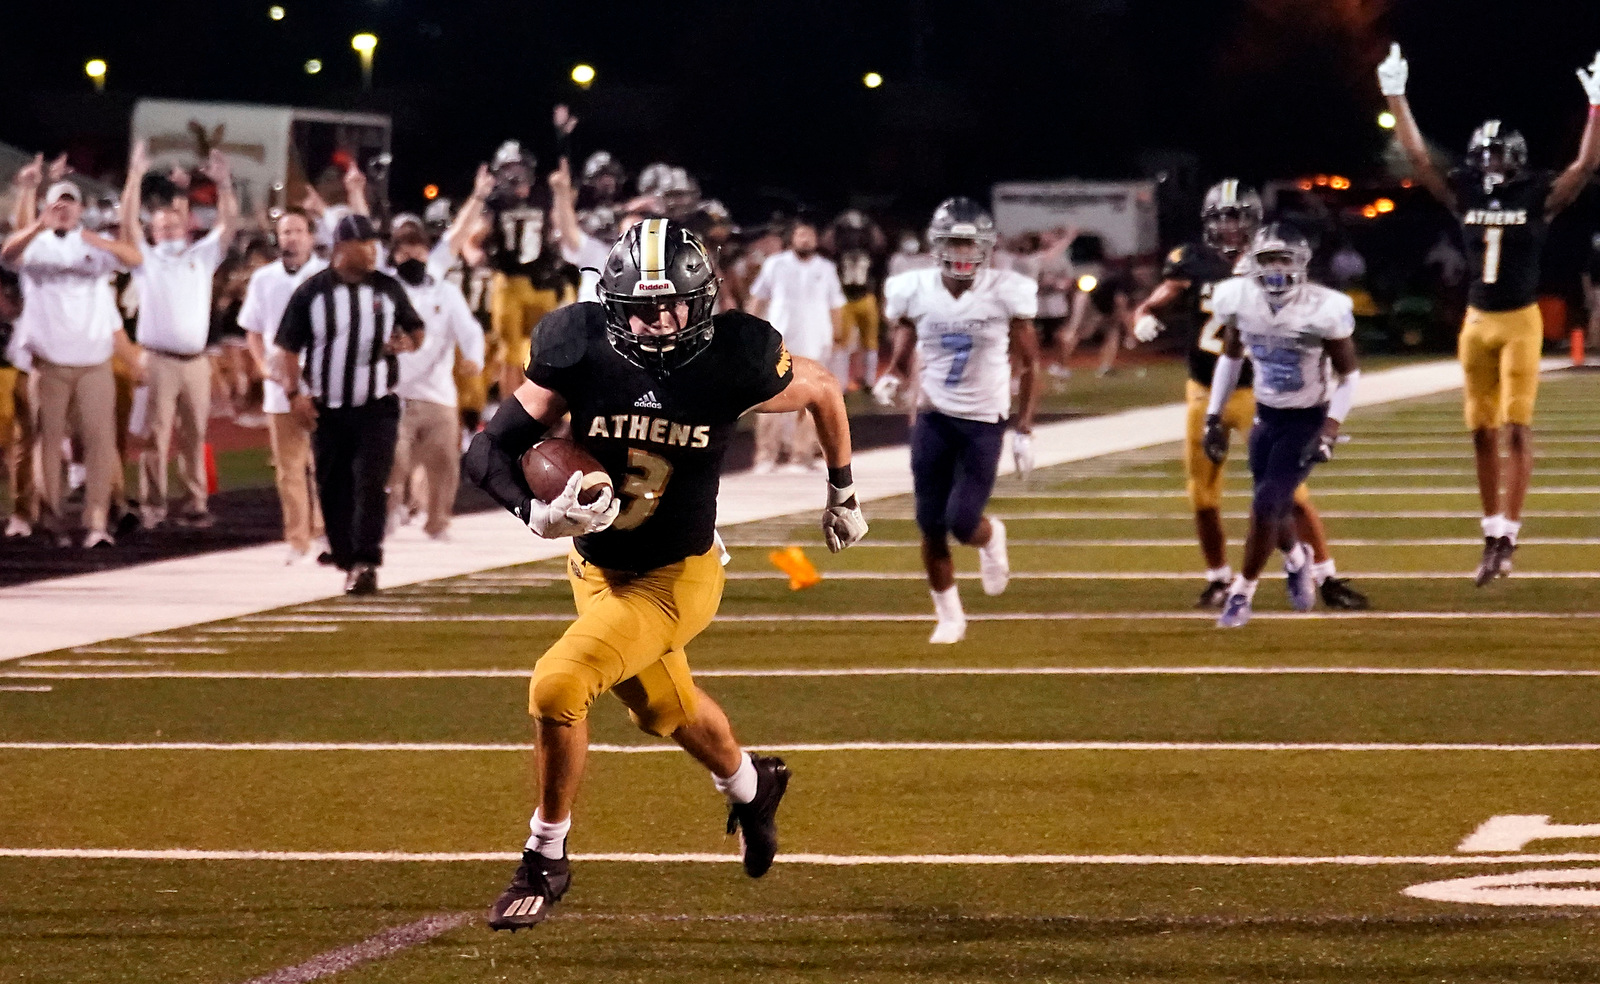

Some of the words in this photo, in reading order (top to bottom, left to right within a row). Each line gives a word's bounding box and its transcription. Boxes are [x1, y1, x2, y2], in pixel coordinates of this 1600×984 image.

[1464, 209, 1527, 225] ATHENS
[1482, 227, 1503, 284] 1
[638, 282, 669, 291] Riddell
[940, 332, 974, 387] 7
[634, 400, 663, 409] adidas
[587, 414, 711, 448] ATHENS
[611, 446, 675, 532] 3
